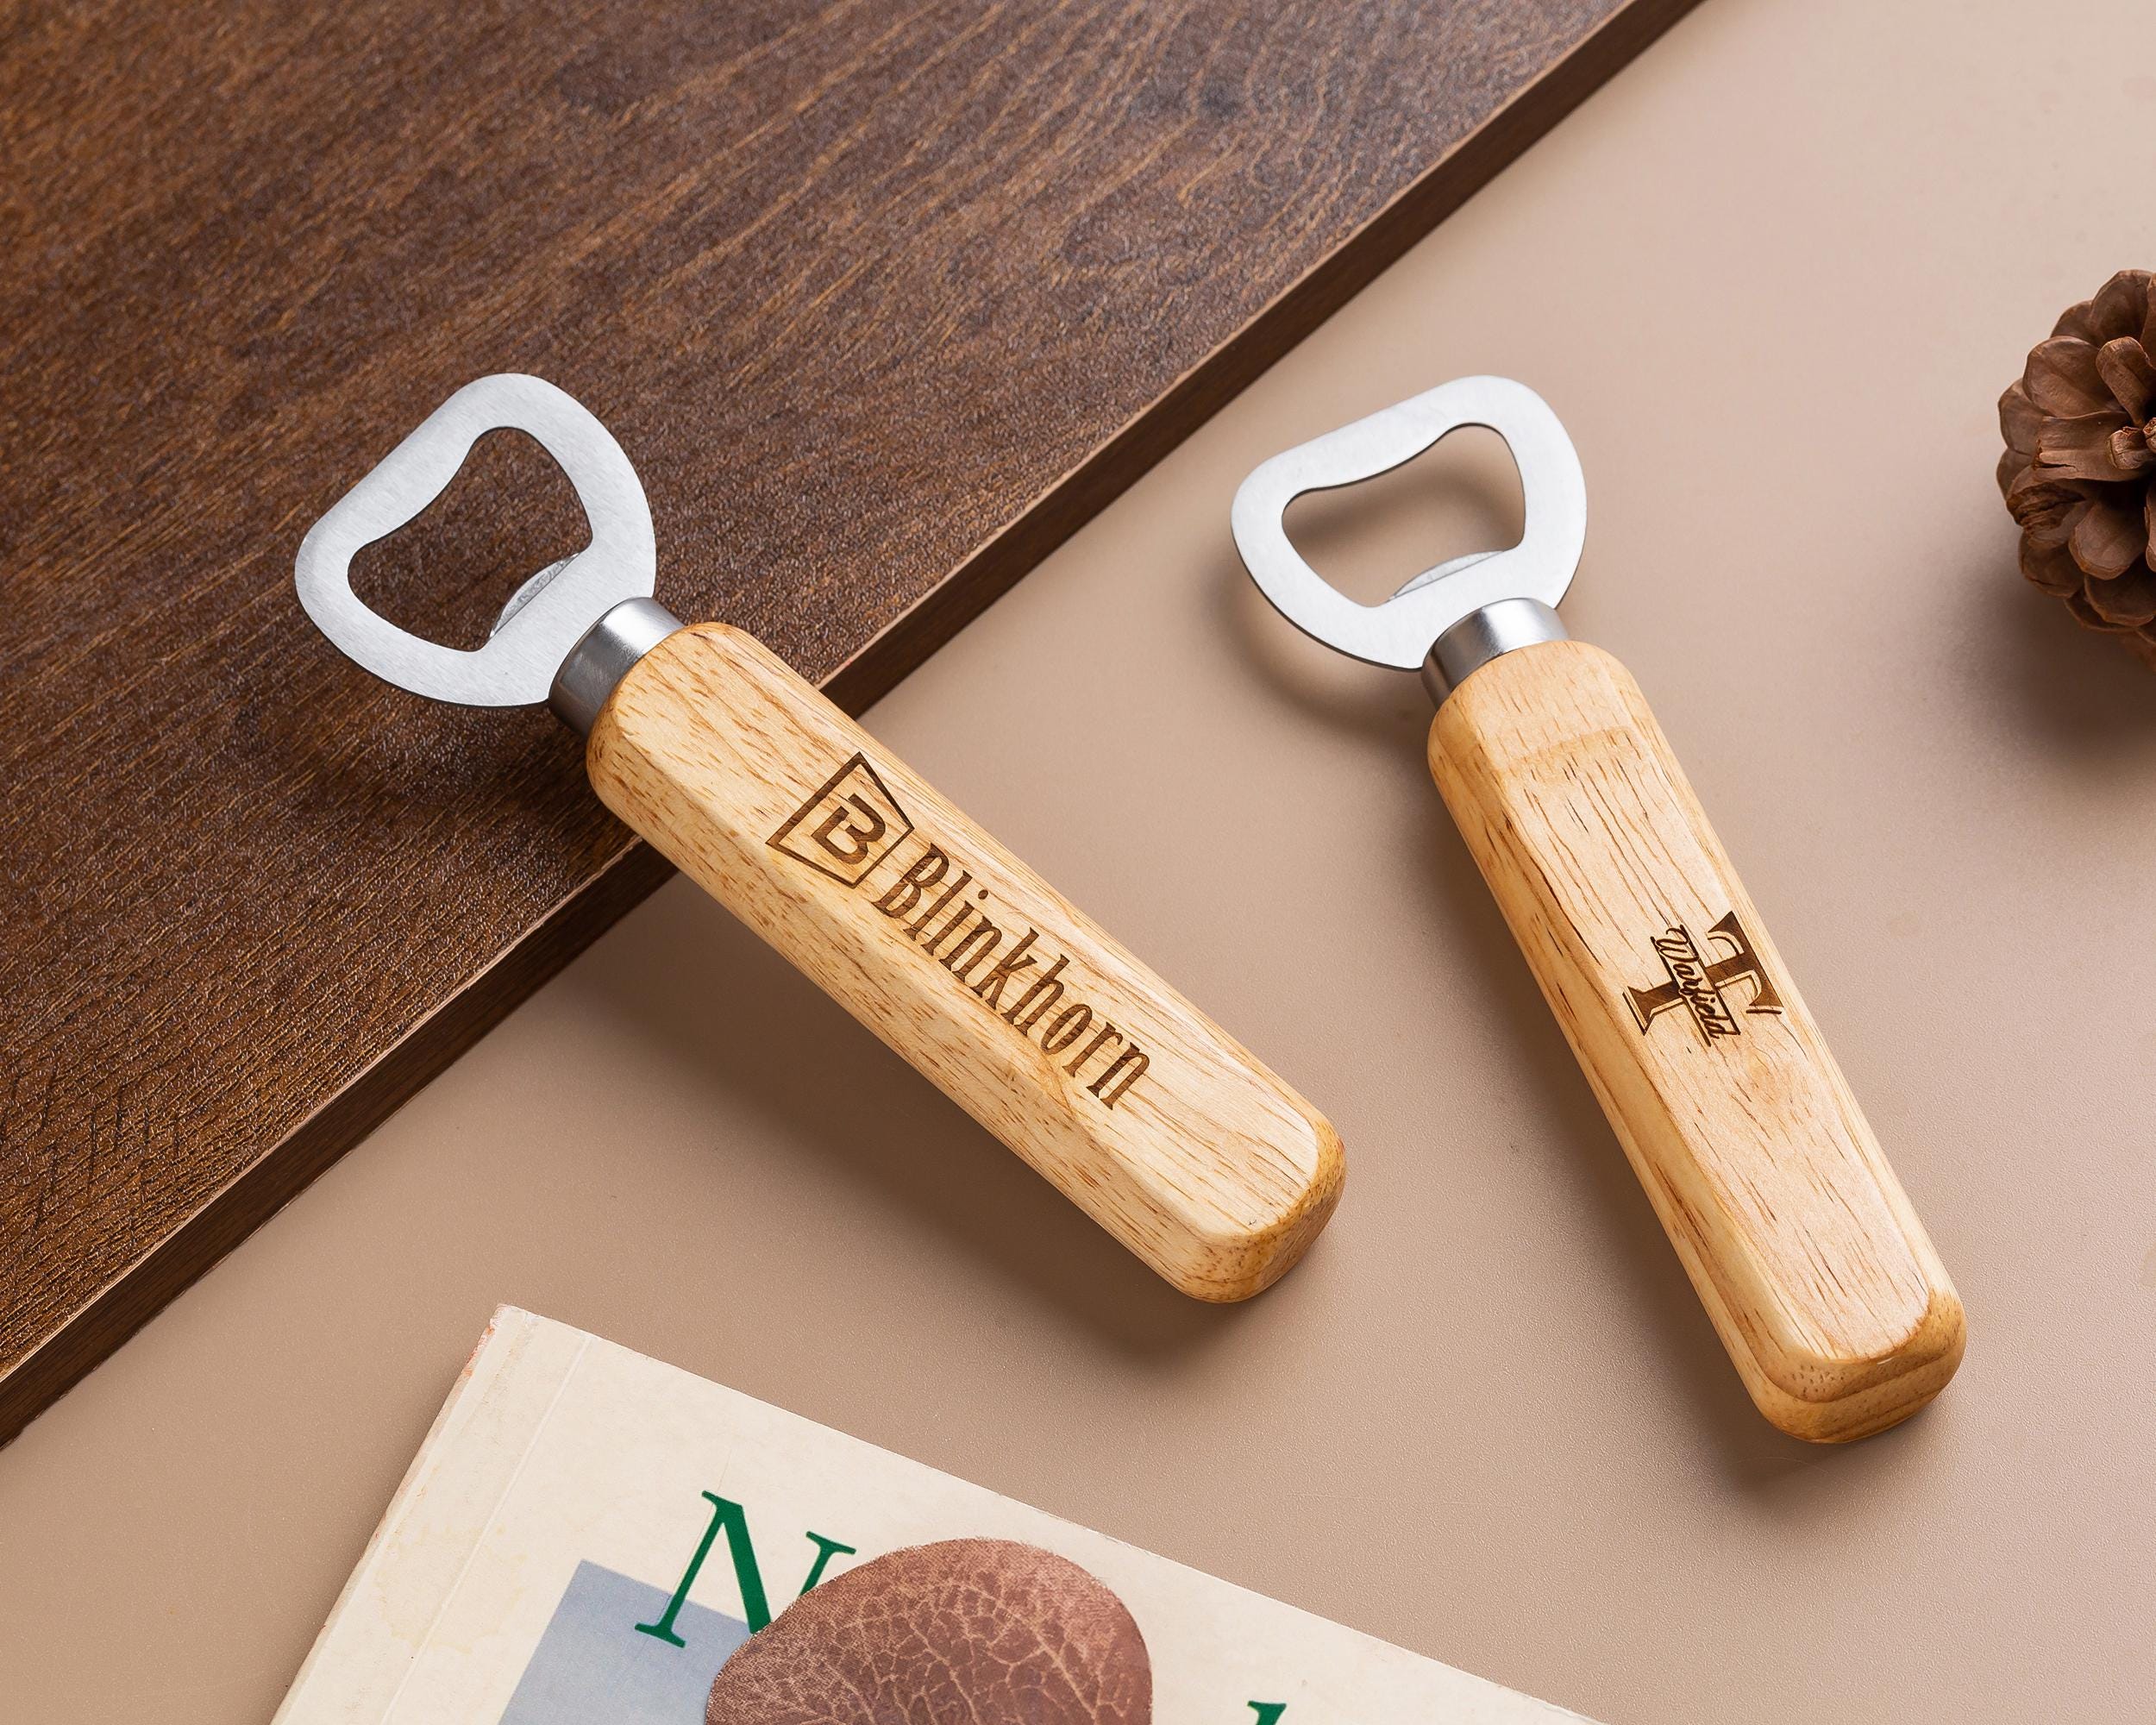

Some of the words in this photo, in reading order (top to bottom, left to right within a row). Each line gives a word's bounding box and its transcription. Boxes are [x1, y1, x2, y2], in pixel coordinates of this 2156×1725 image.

[811, 794, 886, 865] B
[871, 842, 1150, 1110] Blinkhorn
[1622, 910, 1783, 1036] T
[1655, 925, 1740, 1039] Warfield
